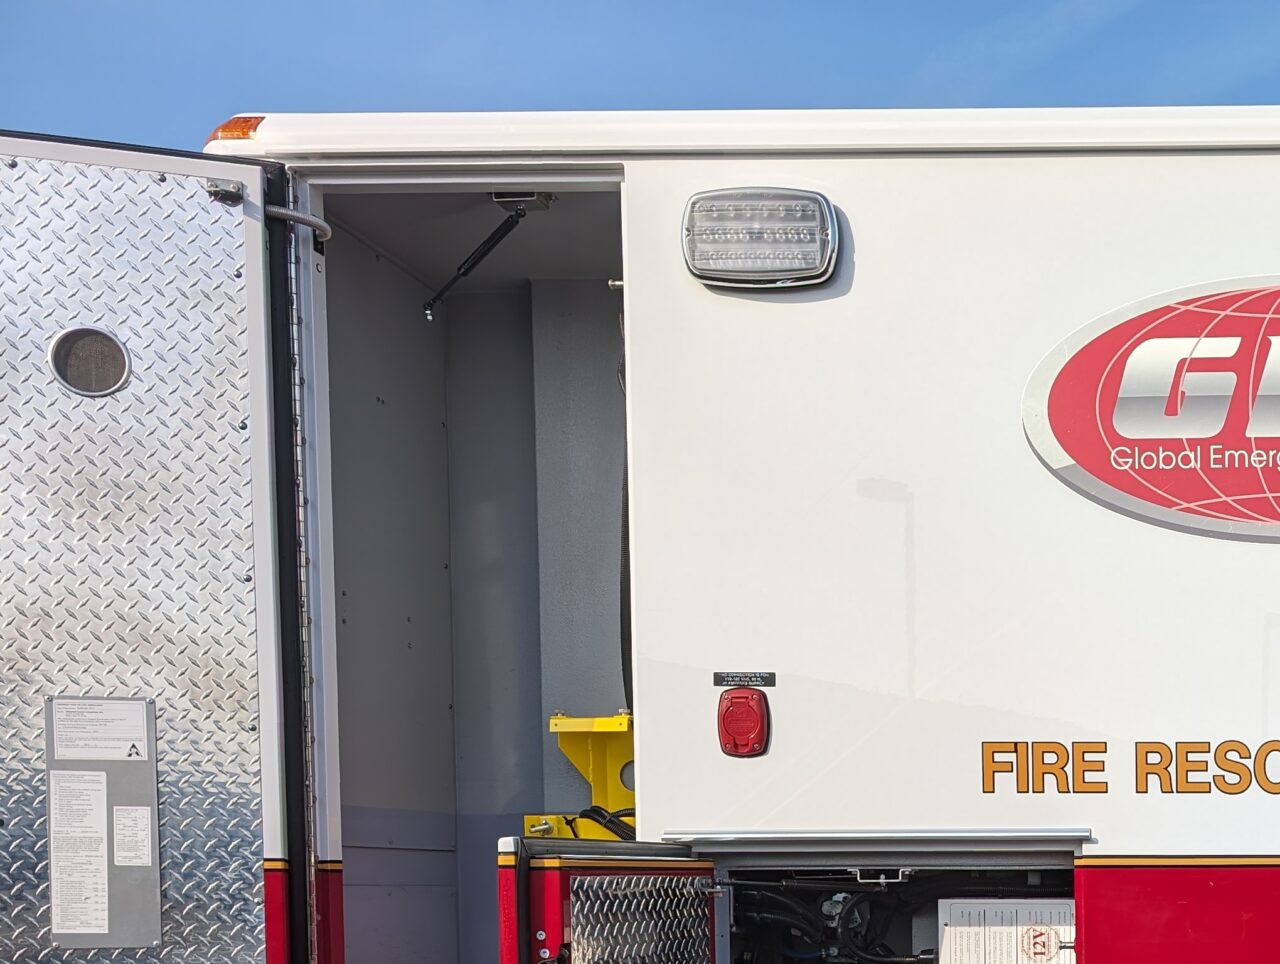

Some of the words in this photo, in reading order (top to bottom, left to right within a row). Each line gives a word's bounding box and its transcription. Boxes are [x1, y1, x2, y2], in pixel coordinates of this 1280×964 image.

[1110, 444, 1201, 471] Global
[981, 740, 1109, 794] FIRE
[1032, 927, 1046, 957] 12V
